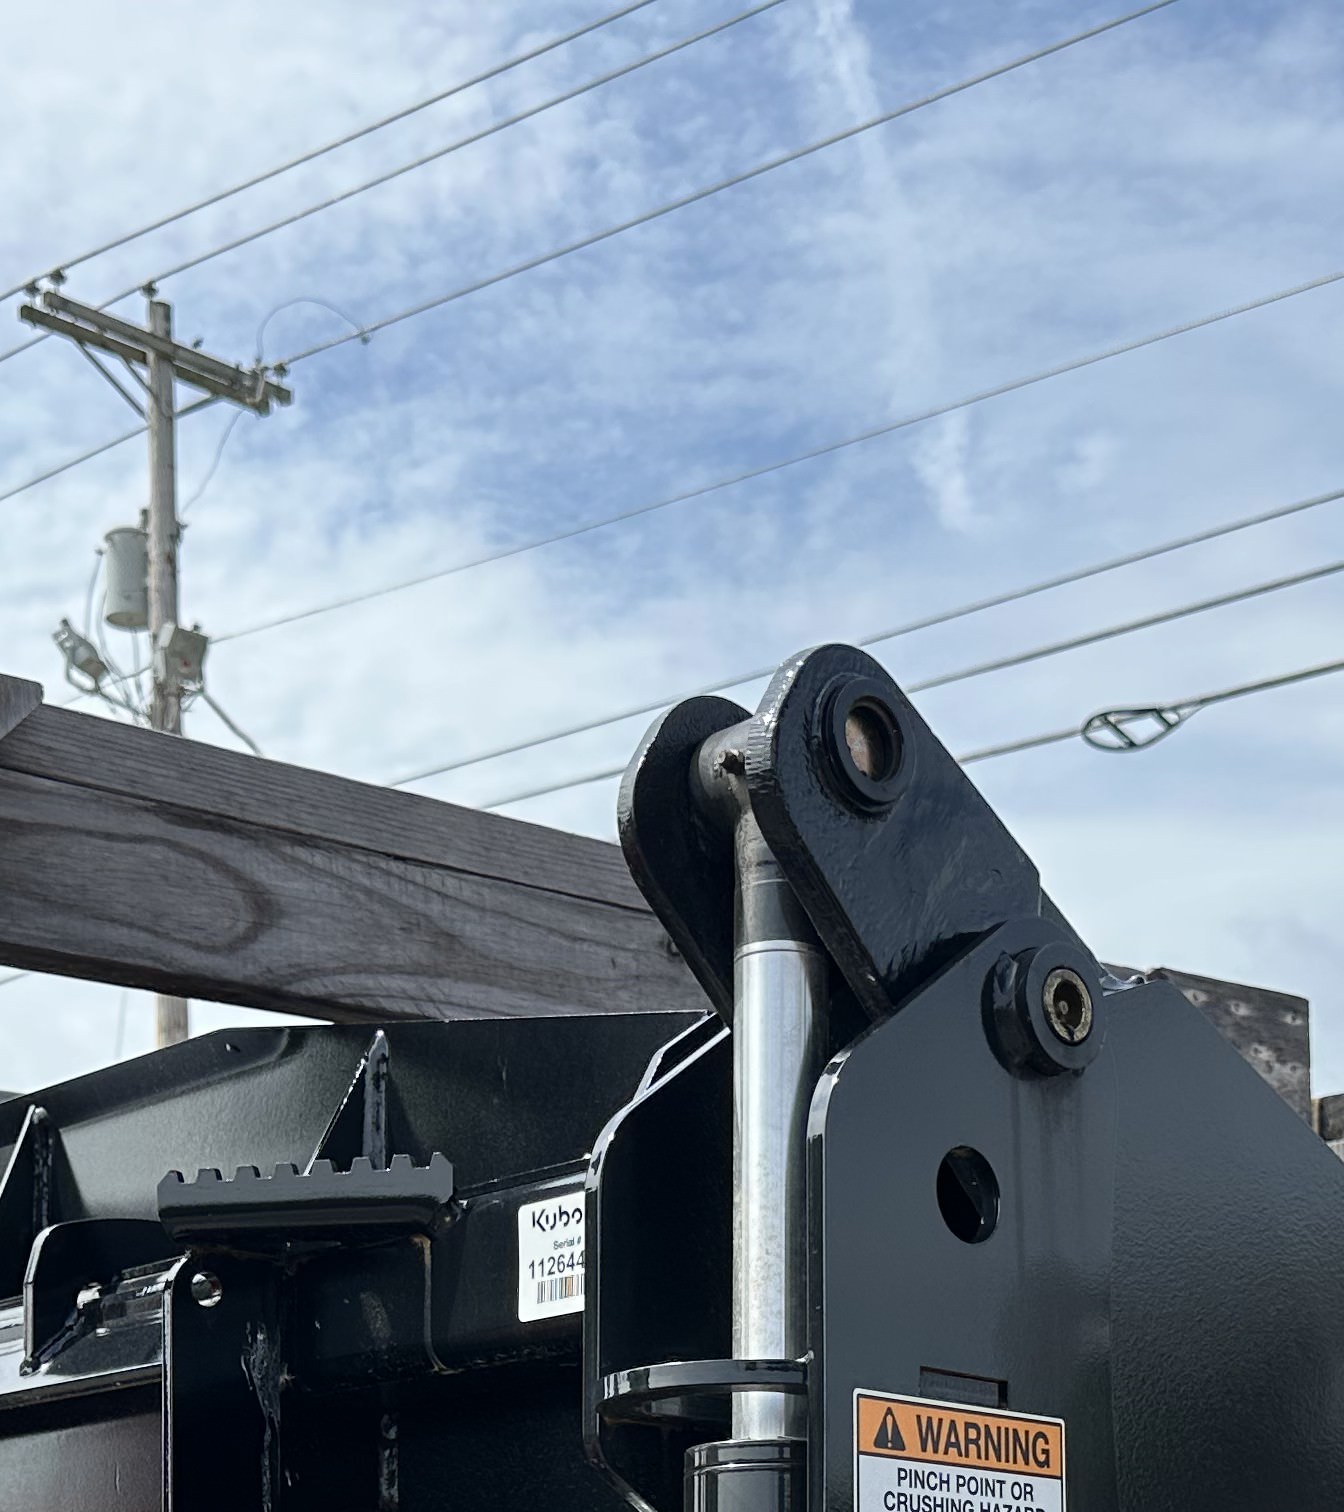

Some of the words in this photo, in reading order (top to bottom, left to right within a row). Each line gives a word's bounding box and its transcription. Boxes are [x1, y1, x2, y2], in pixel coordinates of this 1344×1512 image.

[532, 1205, 582, 1232] Kubo
[553, 1238, 574, 1250] Serial
[529, 1250, 585, 1279] 112644
[916, 1414, 1050, 1468] WARNING
[897, 1467, 950, 1492] PINCH
[956, 1475, 1006, 1498] POINT
[1011, 1482, 1033, 1502] OR
